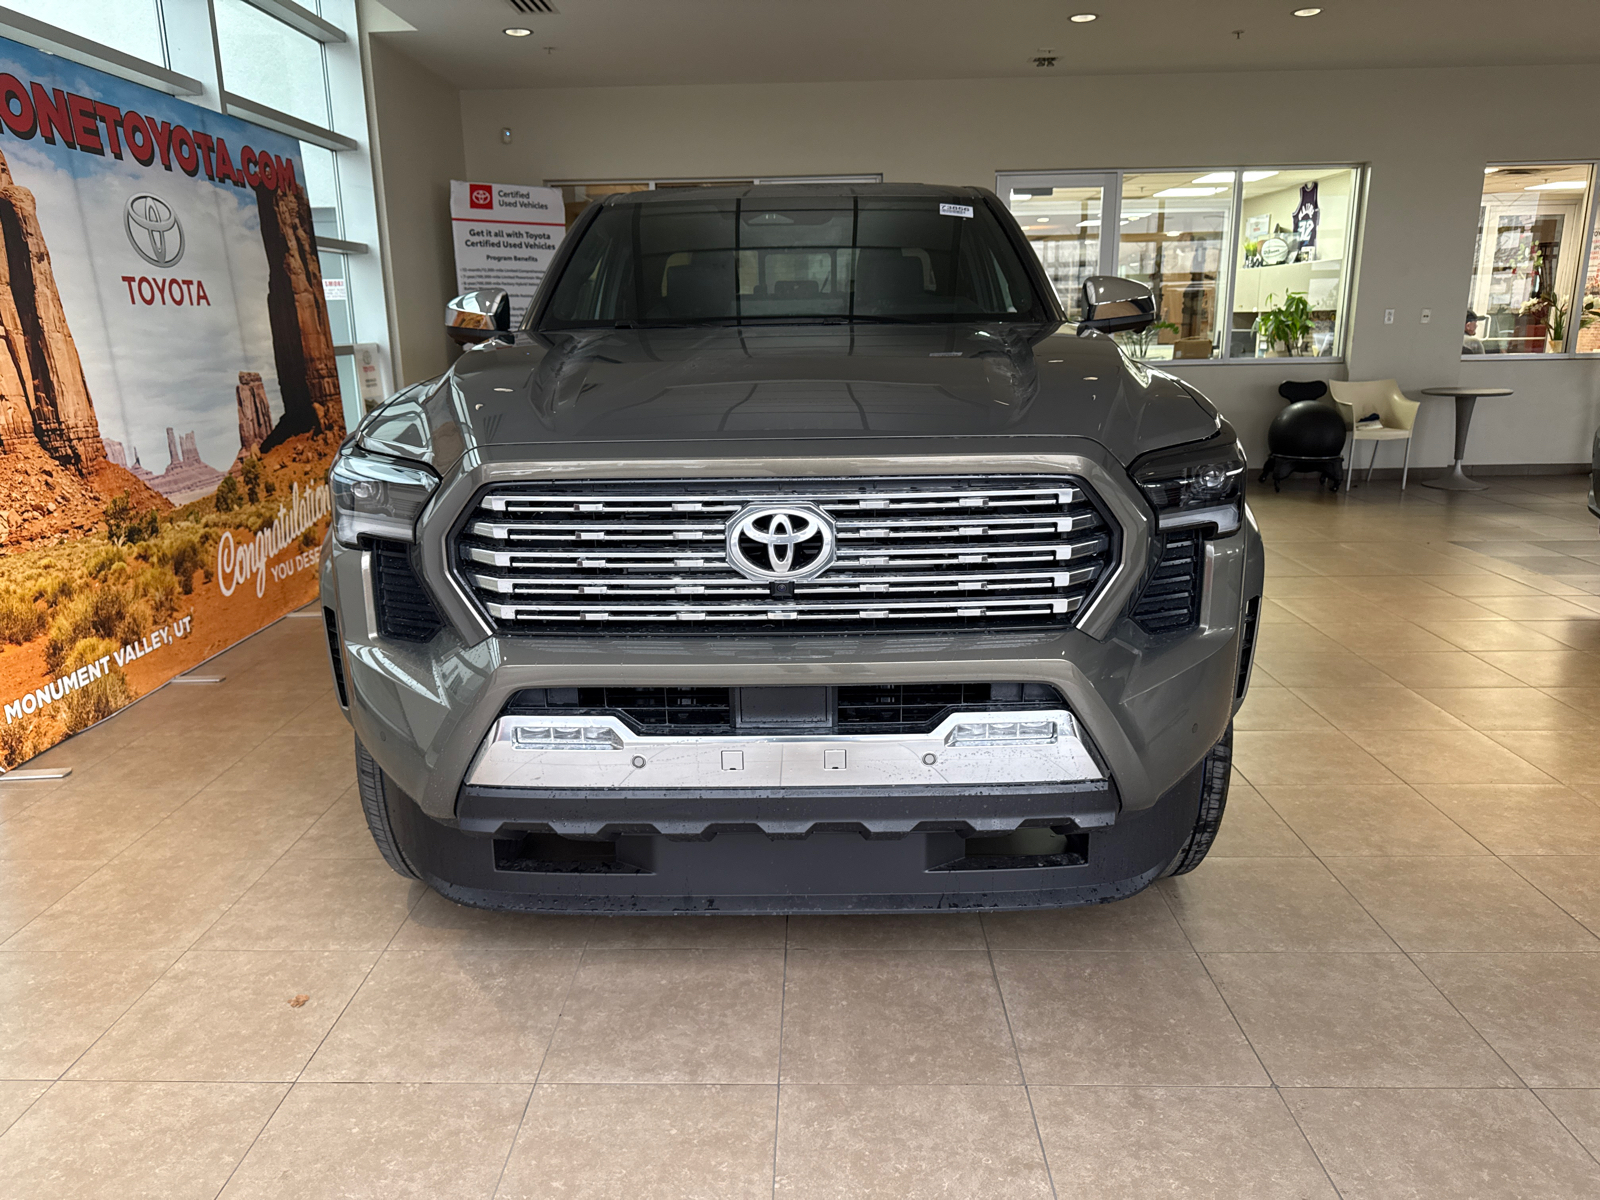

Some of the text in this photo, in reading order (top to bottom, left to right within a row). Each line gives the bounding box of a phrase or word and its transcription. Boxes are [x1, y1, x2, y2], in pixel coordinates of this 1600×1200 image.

[0, 72, 297, 195] ONETOYOTA.COM
[498, 190, 530, 200] Certified
[498, 199, 548, 210] Used Vehicles
[465, 239, 556, 251] Certified Used Vehicles
[469, 228, 551, 241] Get it all with Toyota
[486, 254, 538, 263] Program Benefits
[121, 275, 211, 306] TOYOTA
[217, 479, 331, 599] Congratulation
[270, 545, 323, 583] YOU DESE
[3, 615, 193, 725] MONUMENT VALLEY, UT
